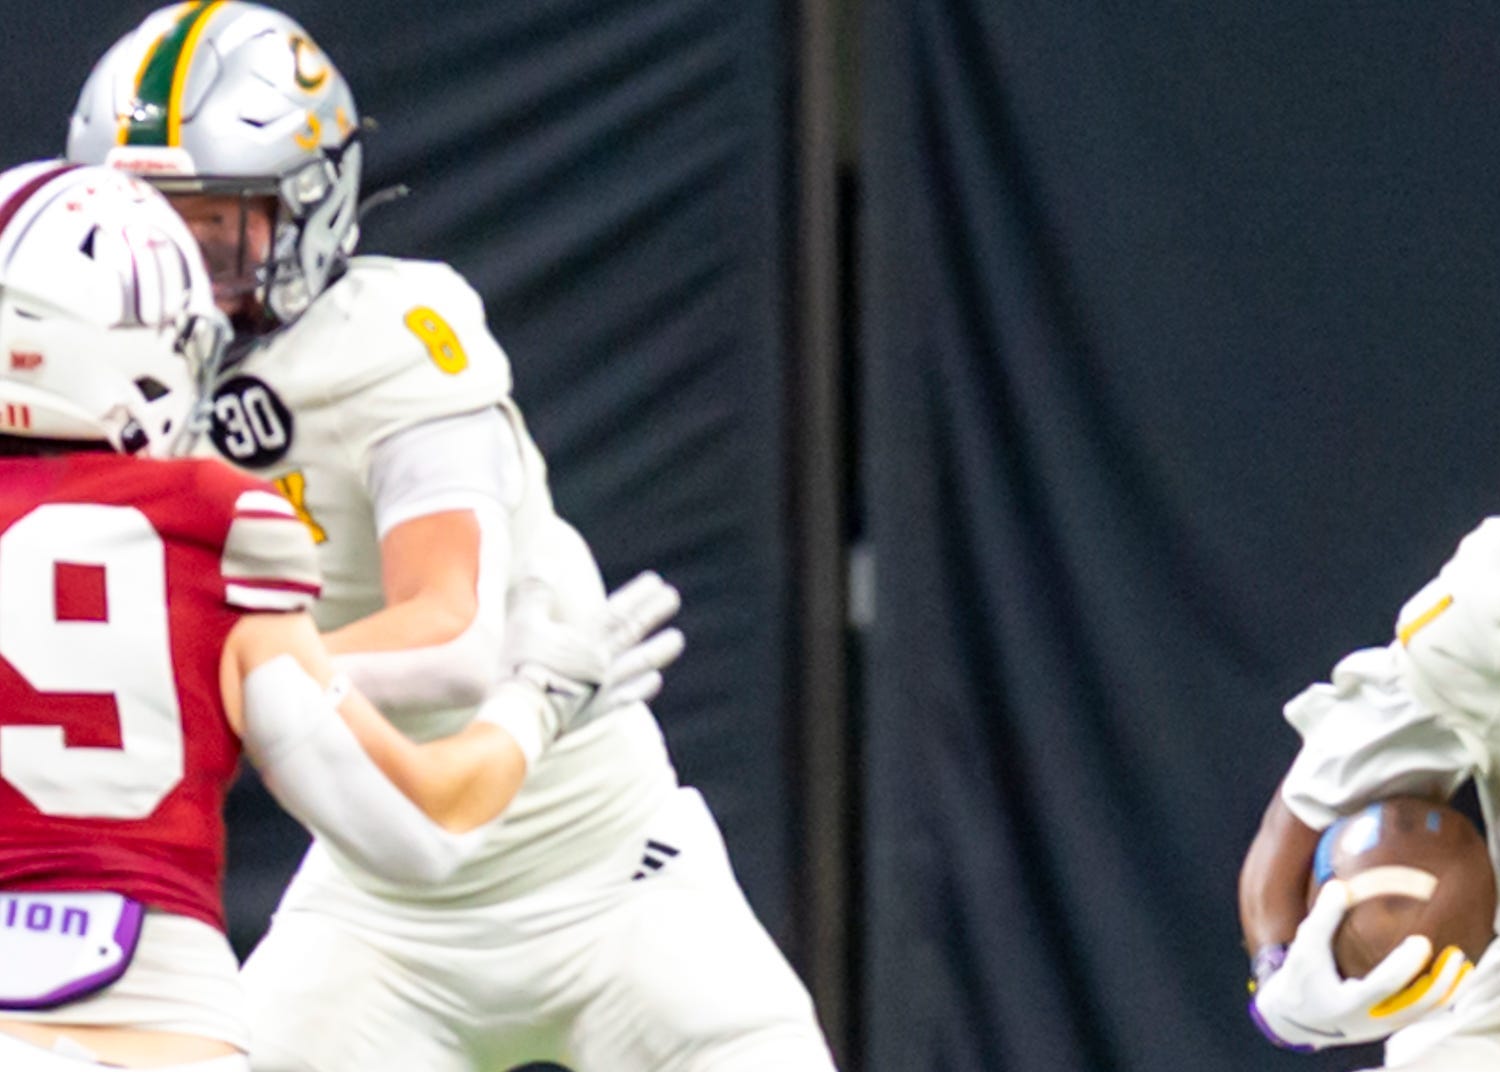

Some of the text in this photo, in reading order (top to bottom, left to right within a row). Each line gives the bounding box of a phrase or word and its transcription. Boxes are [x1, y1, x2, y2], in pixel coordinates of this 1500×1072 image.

[404, 306, 469, 375] 8
[215, 385, 287, 458] 30
[0, 503, 184, 820] 9
